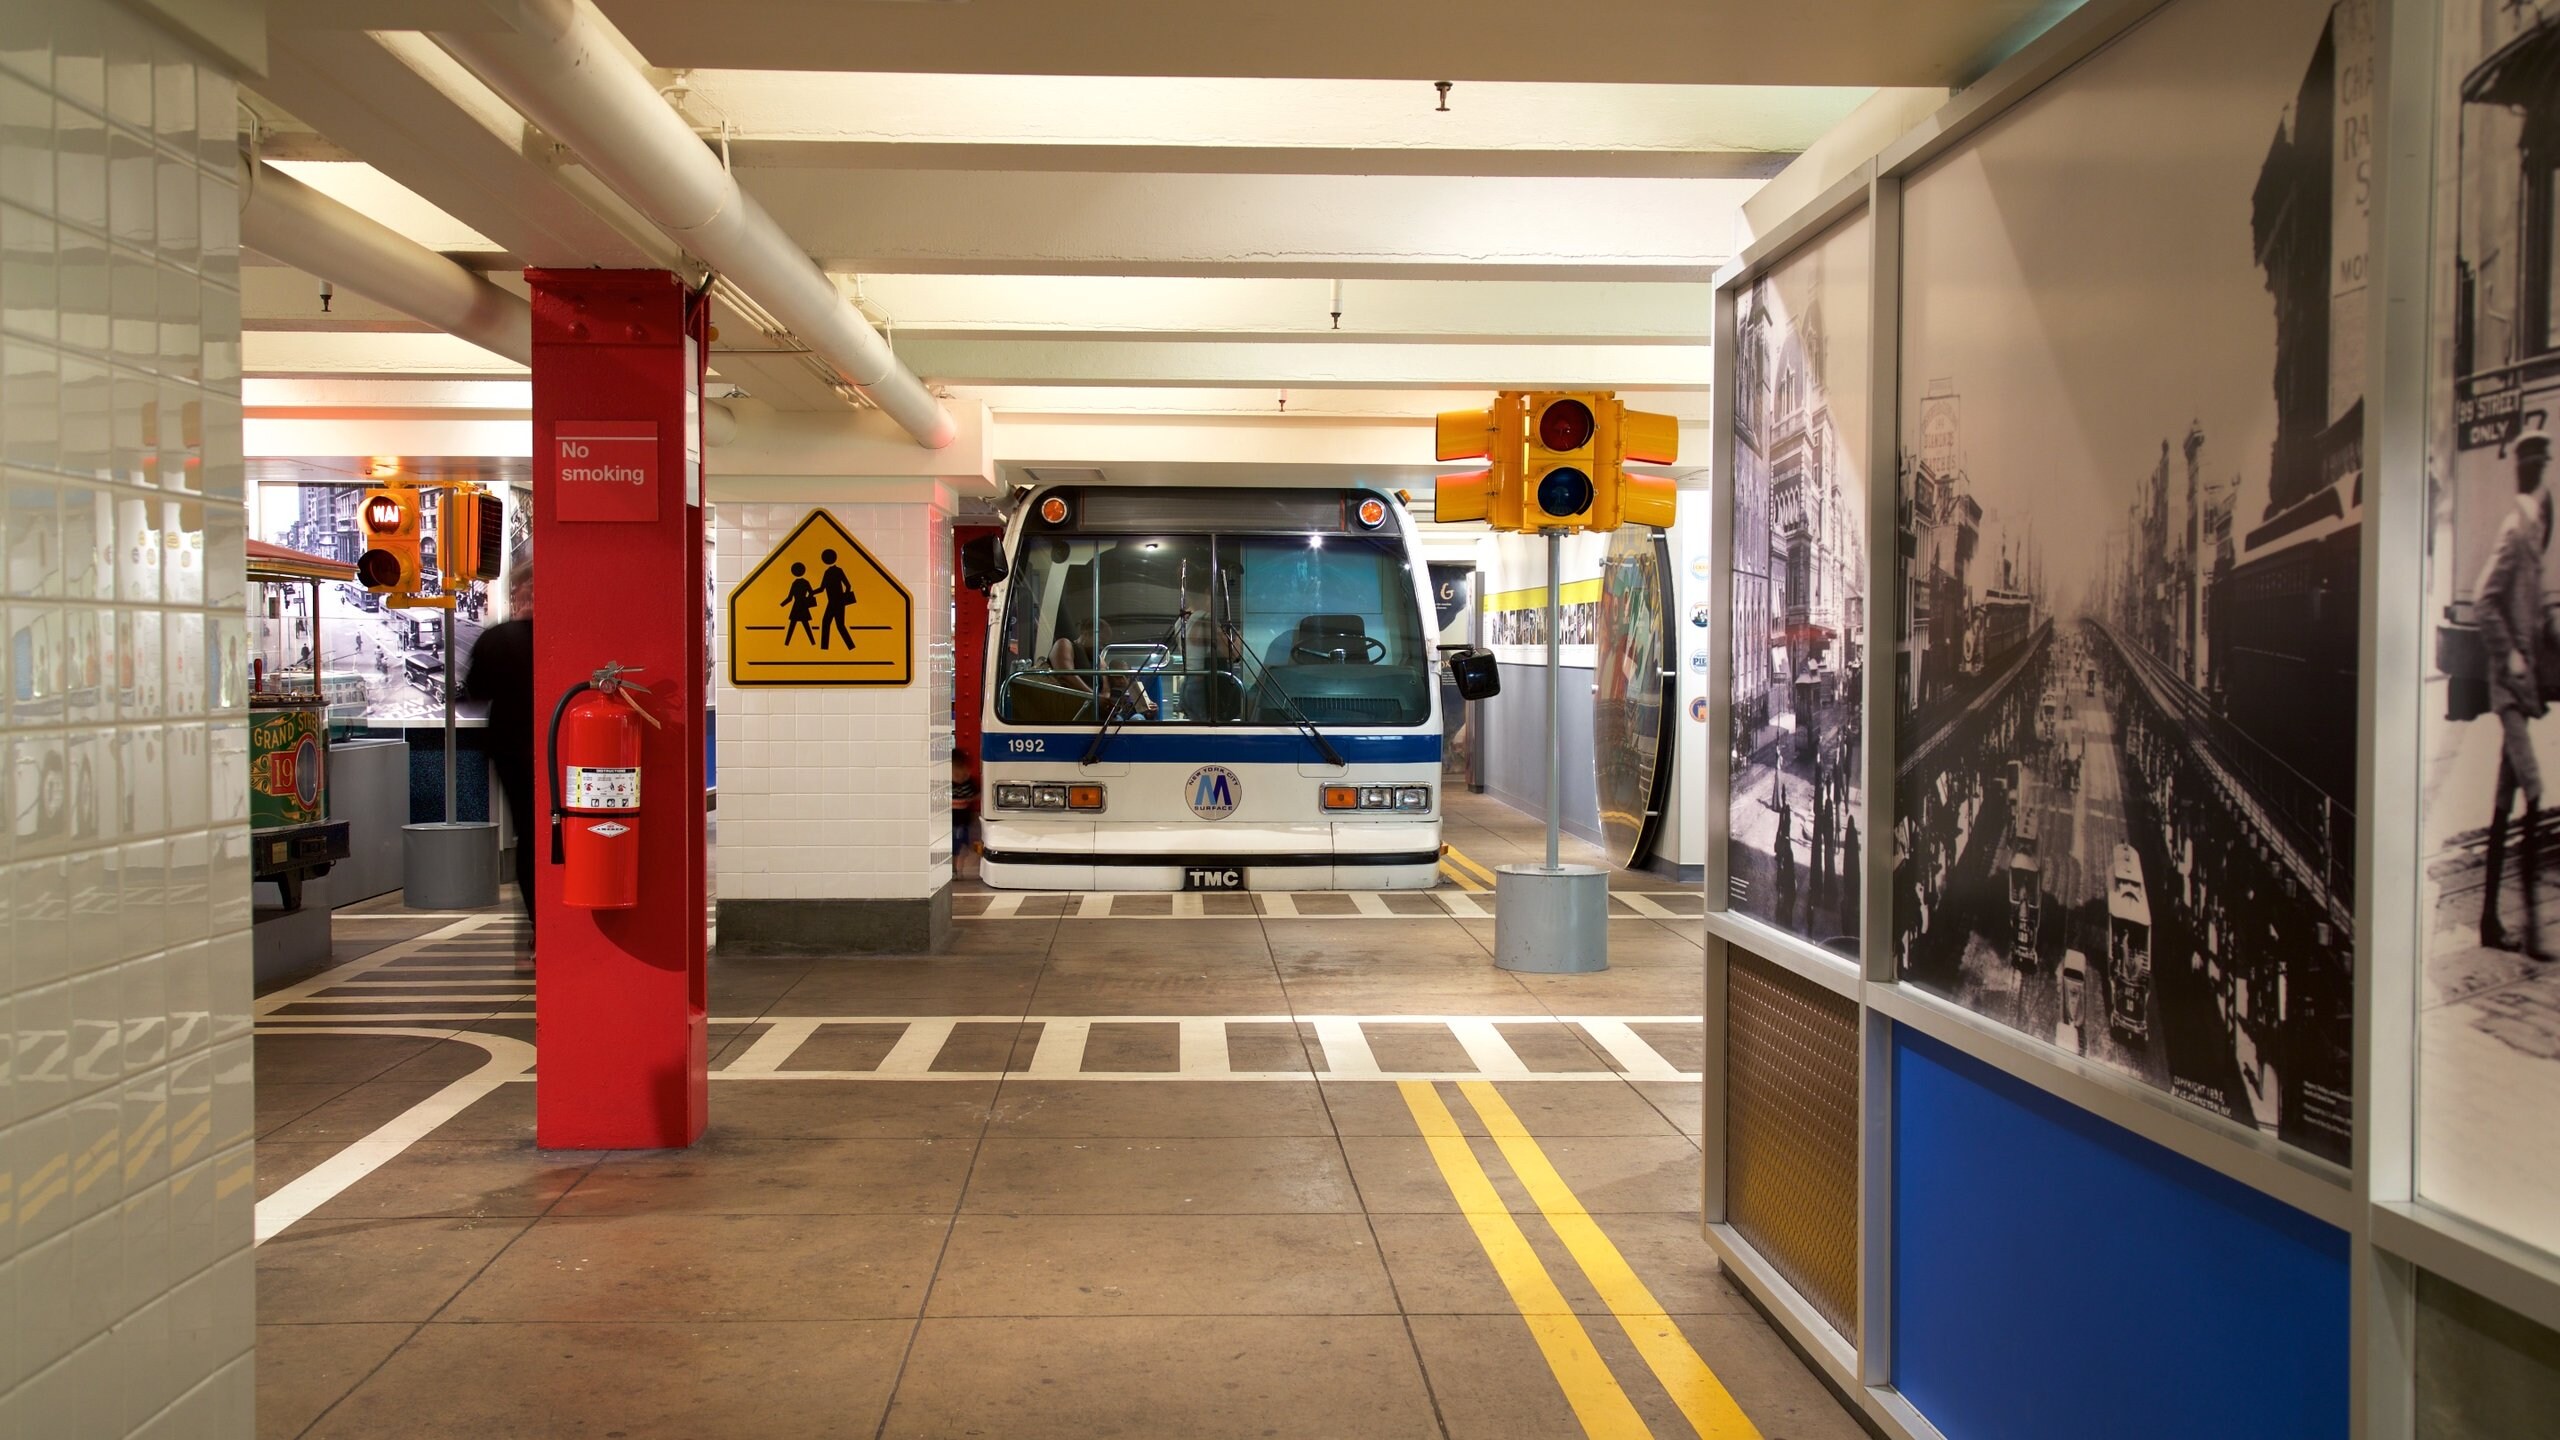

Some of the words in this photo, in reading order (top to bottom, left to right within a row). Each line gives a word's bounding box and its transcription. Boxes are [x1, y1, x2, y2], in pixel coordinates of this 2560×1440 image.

[2478, 389, 2520, 419] STREET
[2470, 421, 2510, 444] ONLY
[562, 441, 589, 458] No
[562, 465, 644, 485] smoking
[254, 722, 295, 749] GRAND
[1008, 739, 1045, 752] 1992
[1188, 771, 1202, 786] NEW
[1226, 771, 1239, 786] CITY
[1189, 871, 1239, 887] TMC
